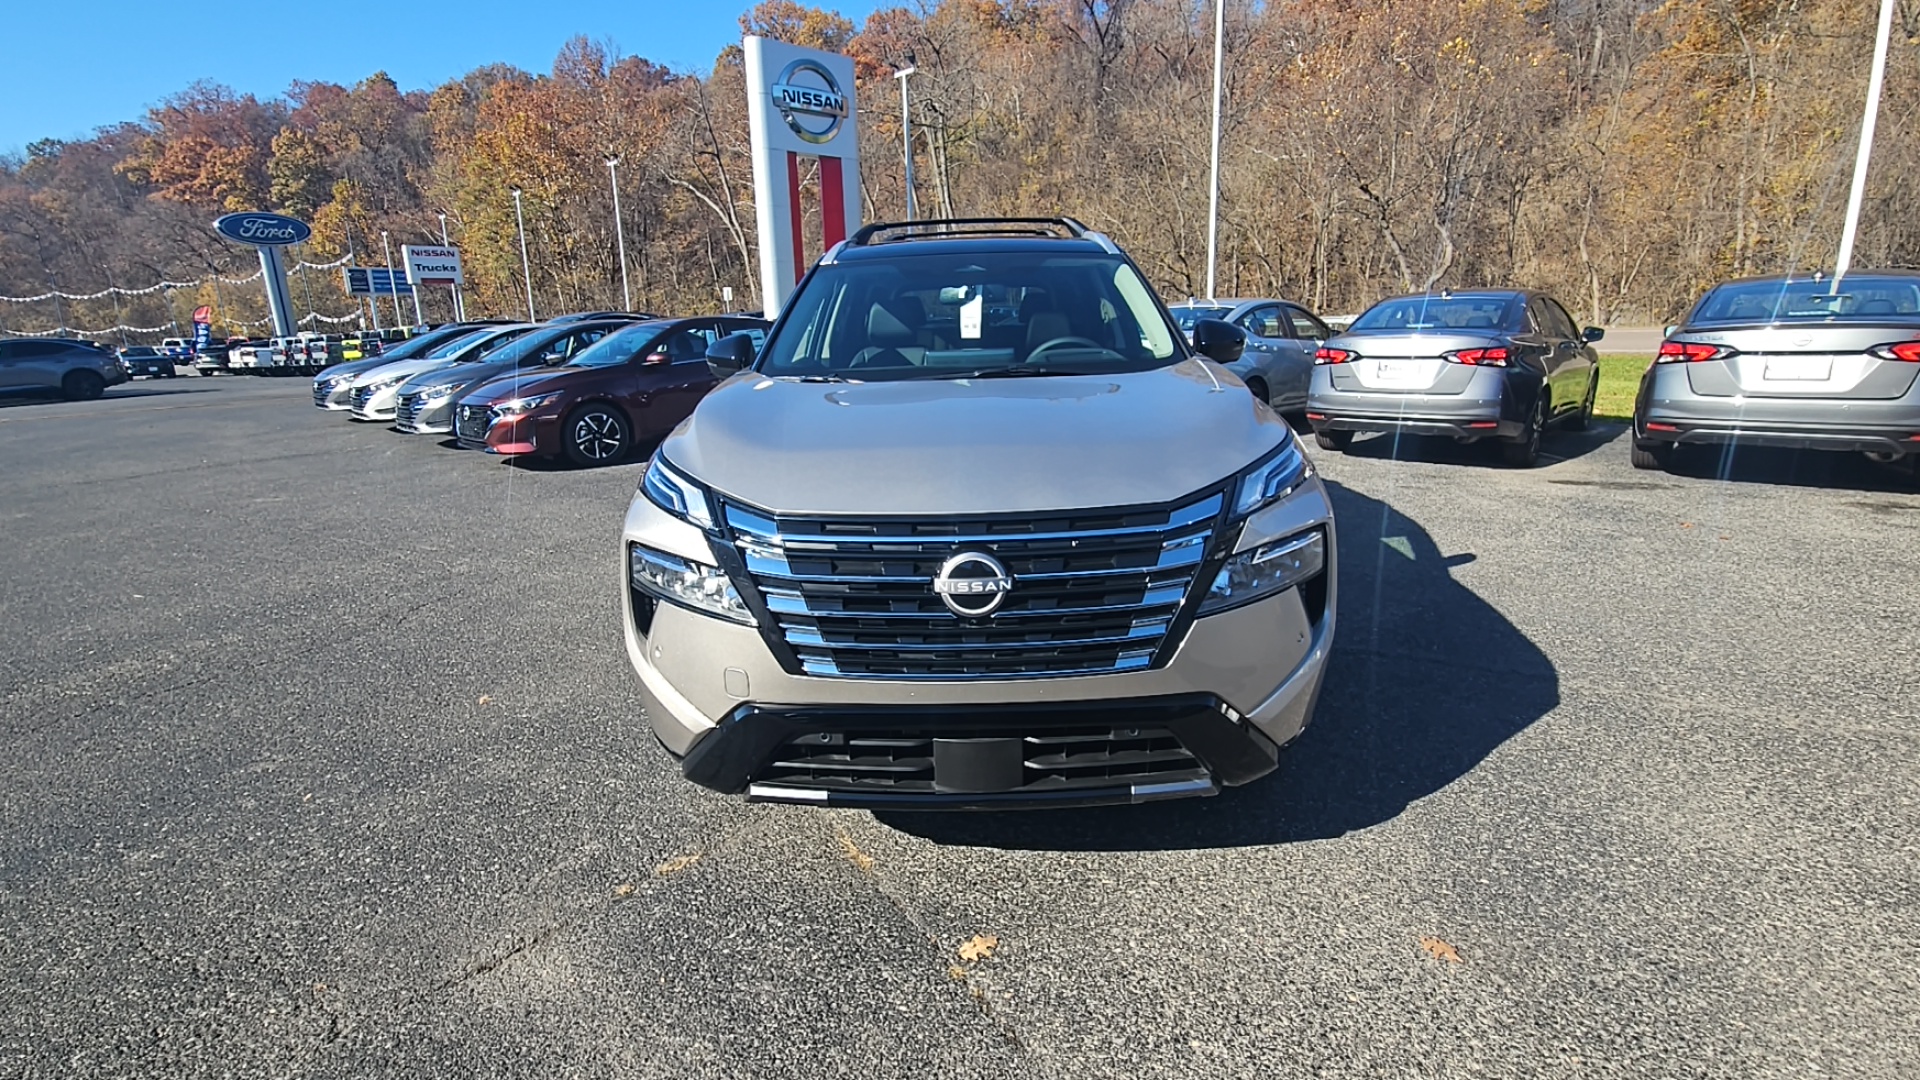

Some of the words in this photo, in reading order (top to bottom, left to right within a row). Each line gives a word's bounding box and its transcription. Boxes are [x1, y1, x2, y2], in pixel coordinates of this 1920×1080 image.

[782, 89, 844, 112] NISSAN
[240, 218, 295, 238] Ford
[411, 249, 455, 257] NISSAN
[414, 263, 457, 272] Trucks
[937, 580, 1012, 592] NISSAN
